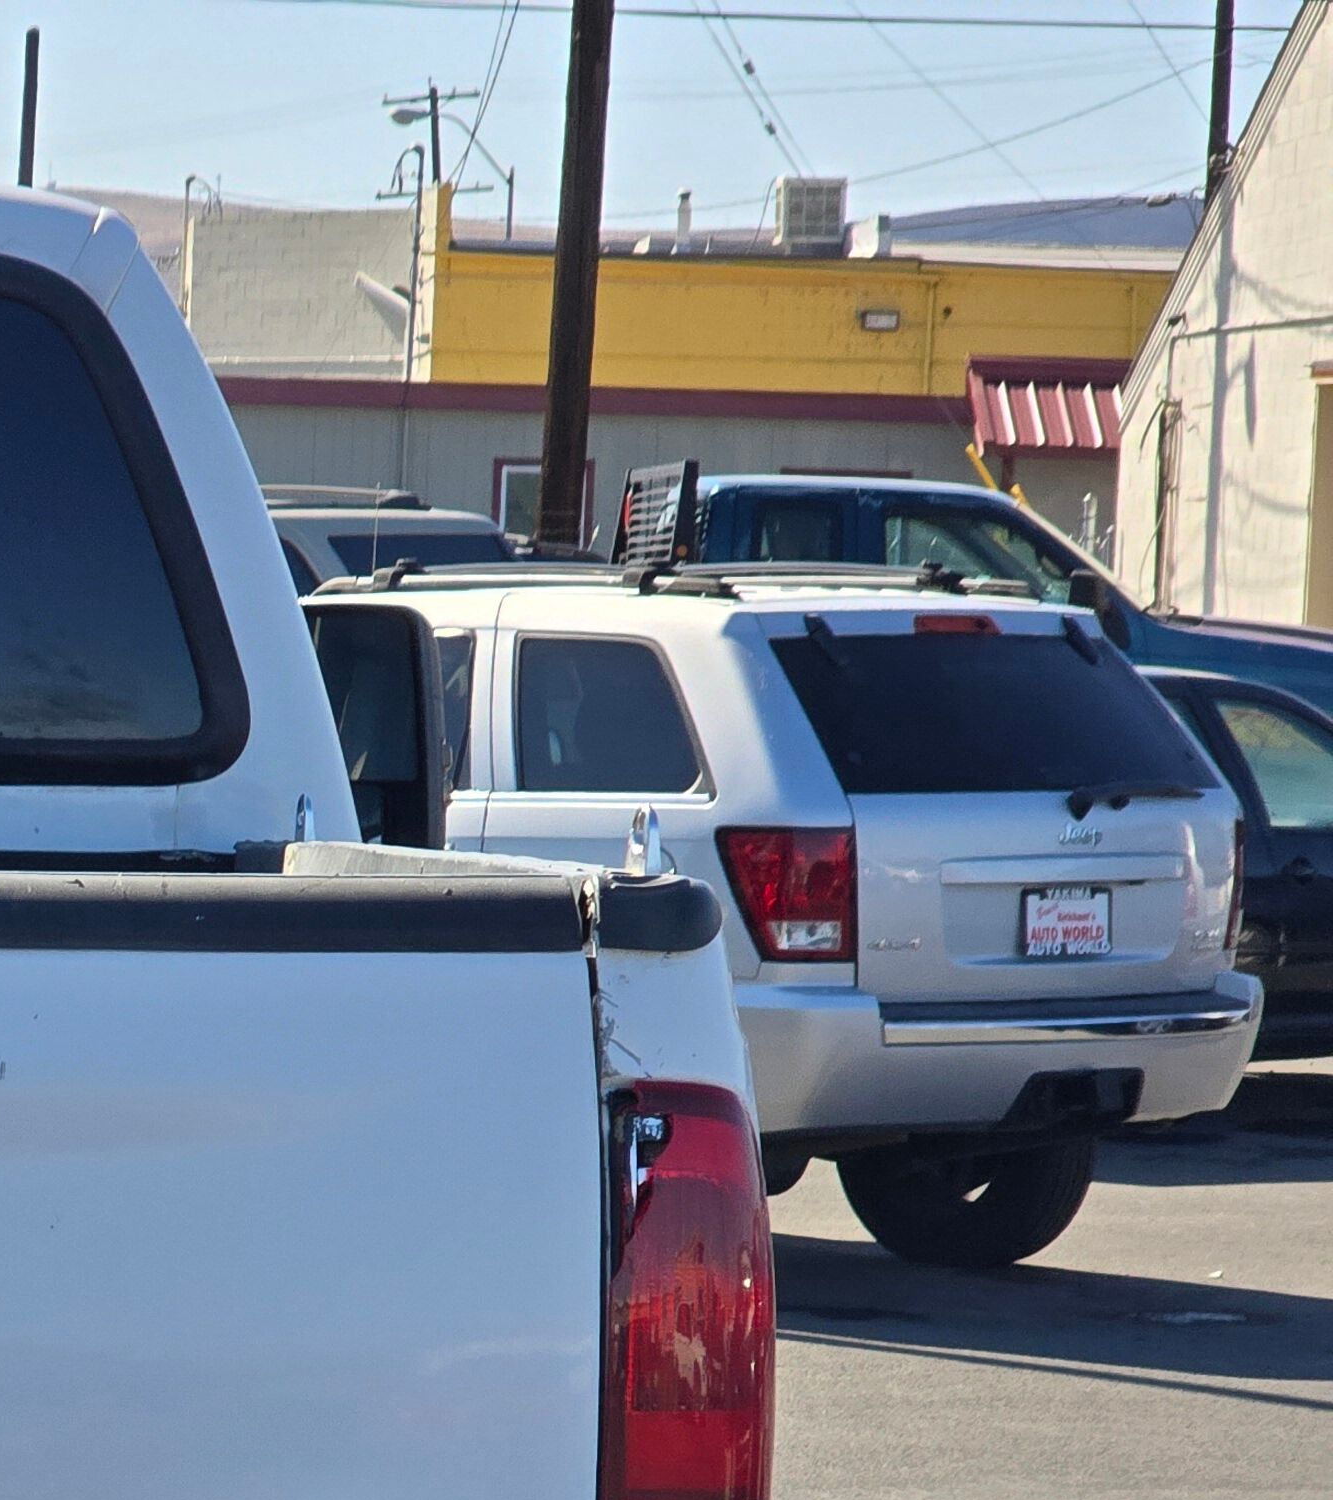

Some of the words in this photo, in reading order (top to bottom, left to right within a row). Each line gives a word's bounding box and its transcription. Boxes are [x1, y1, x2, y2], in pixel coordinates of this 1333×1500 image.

[1031, 926, 1058, 941] AUTO
[1061, 926, 1104, 940] WORLD
[1027, 942, 1062, 955] AUTO
[1067, 942, 1111, 954] WORLD
